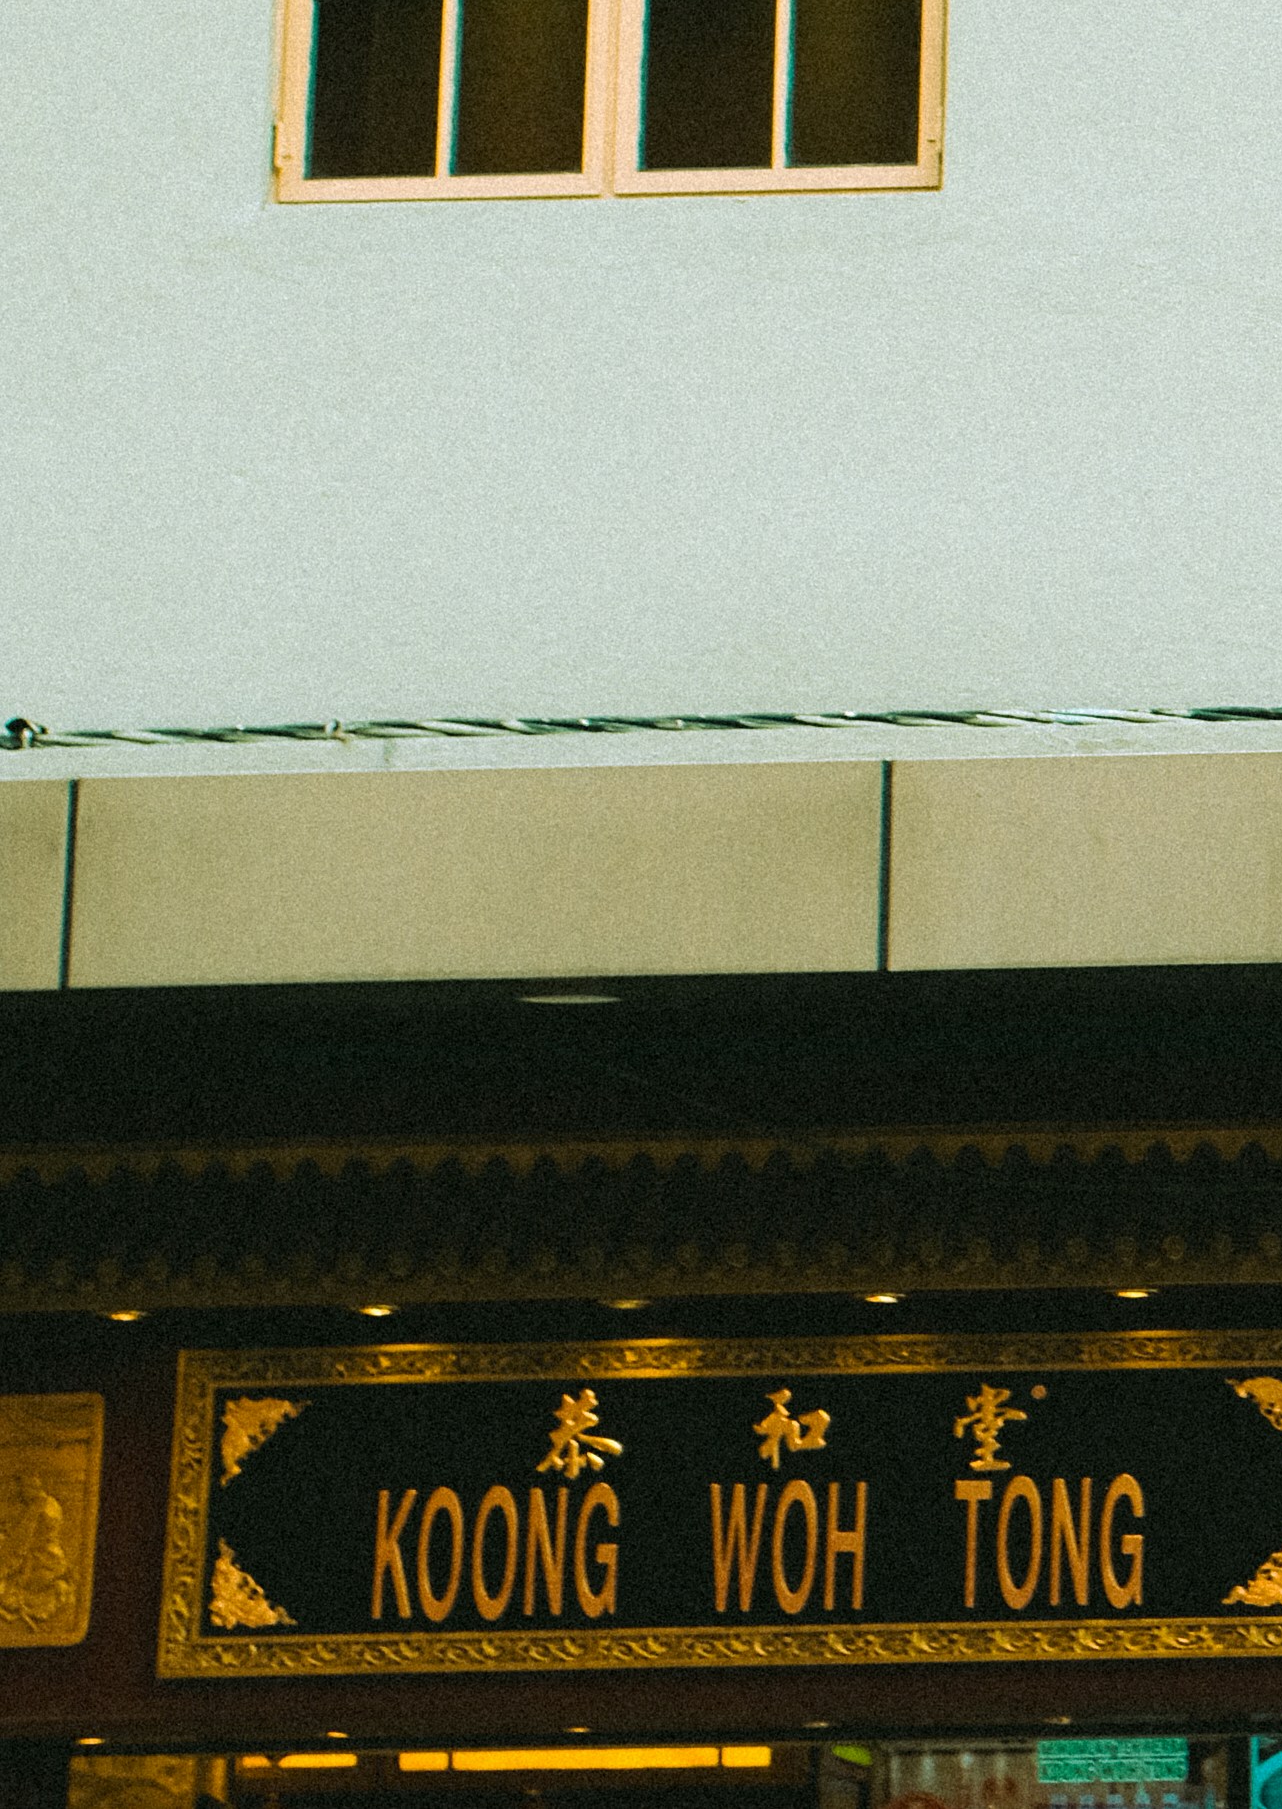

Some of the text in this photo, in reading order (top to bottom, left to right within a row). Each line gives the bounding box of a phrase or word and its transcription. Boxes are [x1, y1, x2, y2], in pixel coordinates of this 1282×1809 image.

[371, 1473, 1145, 1622] KOONG WOH TONG
